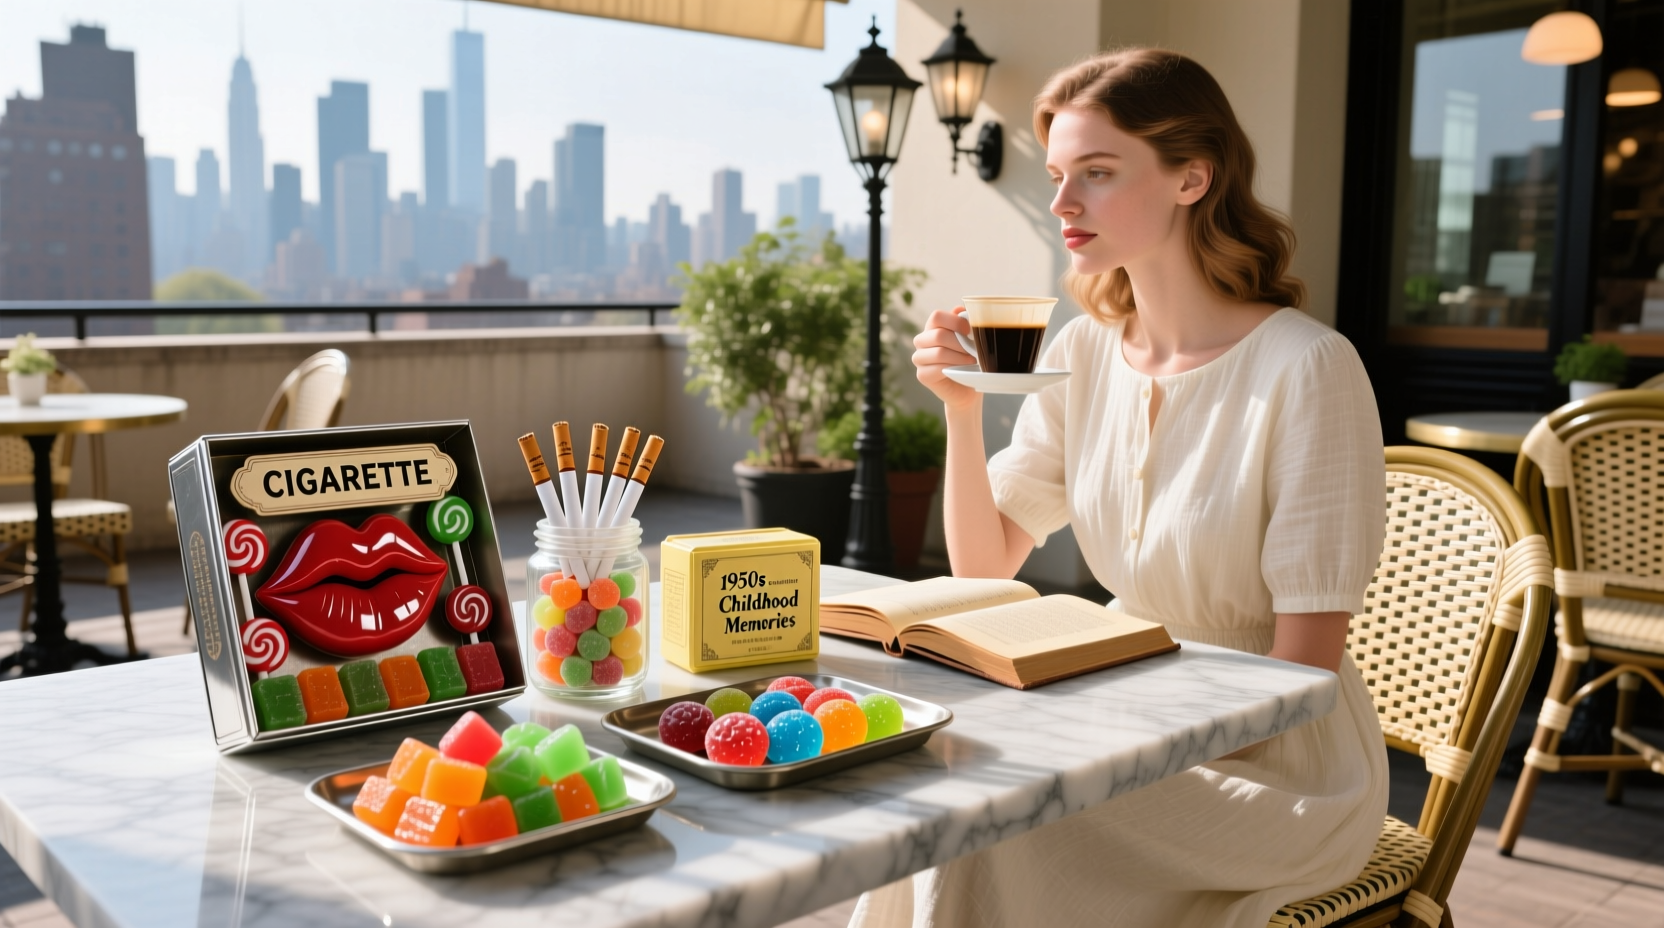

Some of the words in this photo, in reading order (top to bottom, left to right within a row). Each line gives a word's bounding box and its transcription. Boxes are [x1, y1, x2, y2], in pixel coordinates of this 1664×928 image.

[263, 459, 433, 498] CIGARETTE
[720, 570, 766, 591] 1950s
[719, 589, 799, 614] Childhood
[724, 612, 796, 635] Memories
